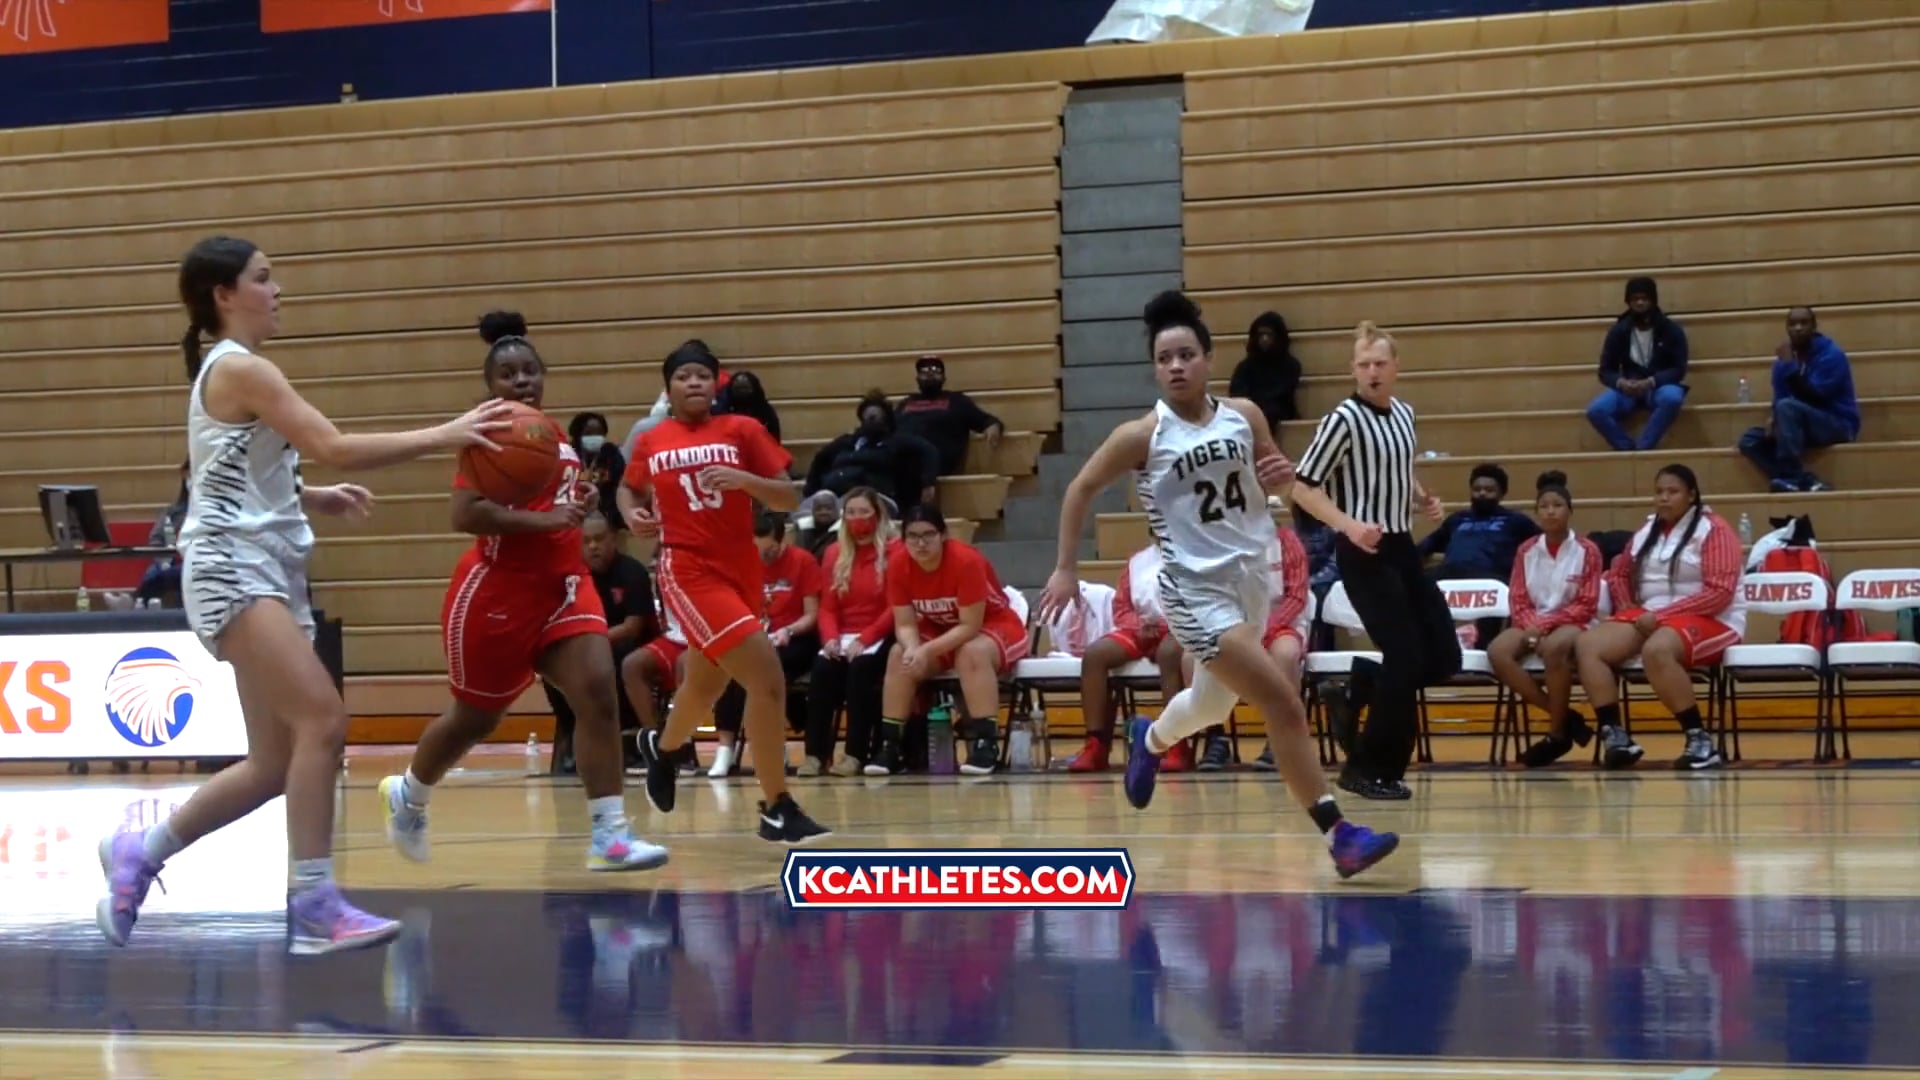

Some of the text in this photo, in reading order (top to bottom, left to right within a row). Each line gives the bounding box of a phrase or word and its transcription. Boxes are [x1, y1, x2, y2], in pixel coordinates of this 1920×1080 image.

[1194, 471, 1246, 523] 24
[1444, 589, 1498, 608] AWKS
[1745, 582, 1813, 601] HAWKS
